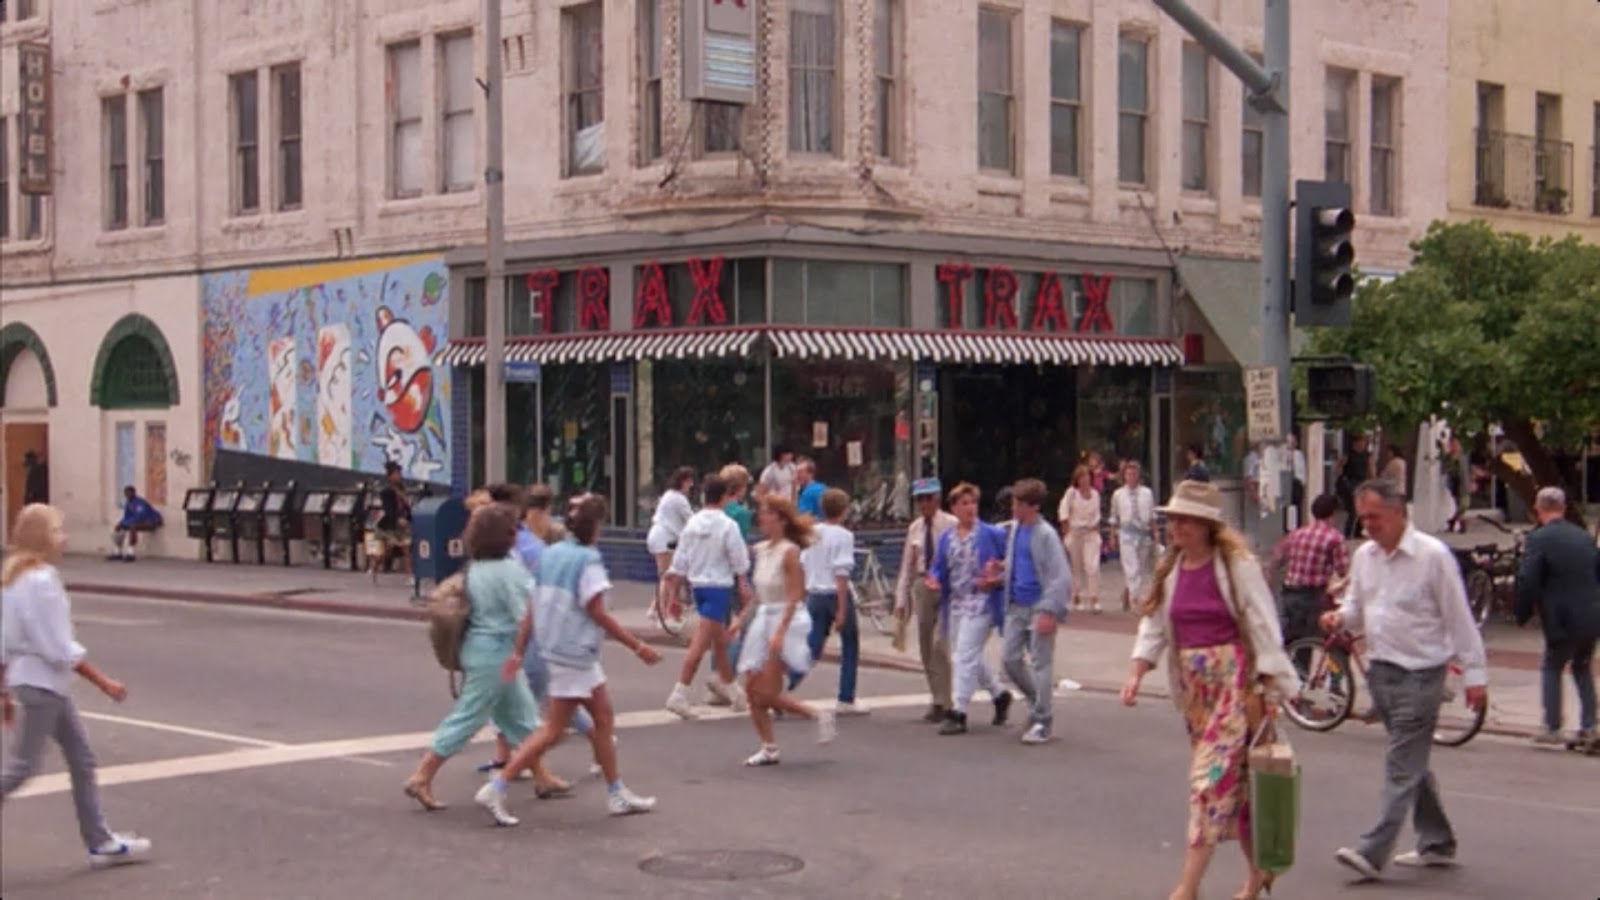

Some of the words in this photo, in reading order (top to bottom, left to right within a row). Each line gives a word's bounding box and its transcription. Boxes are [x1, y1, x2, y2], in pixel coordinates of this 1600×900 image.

[26, 53, 46, 180] HOTEL
[526, 255, 727, 333] TRAX
[936, 259, 1116, 333] TRAX
